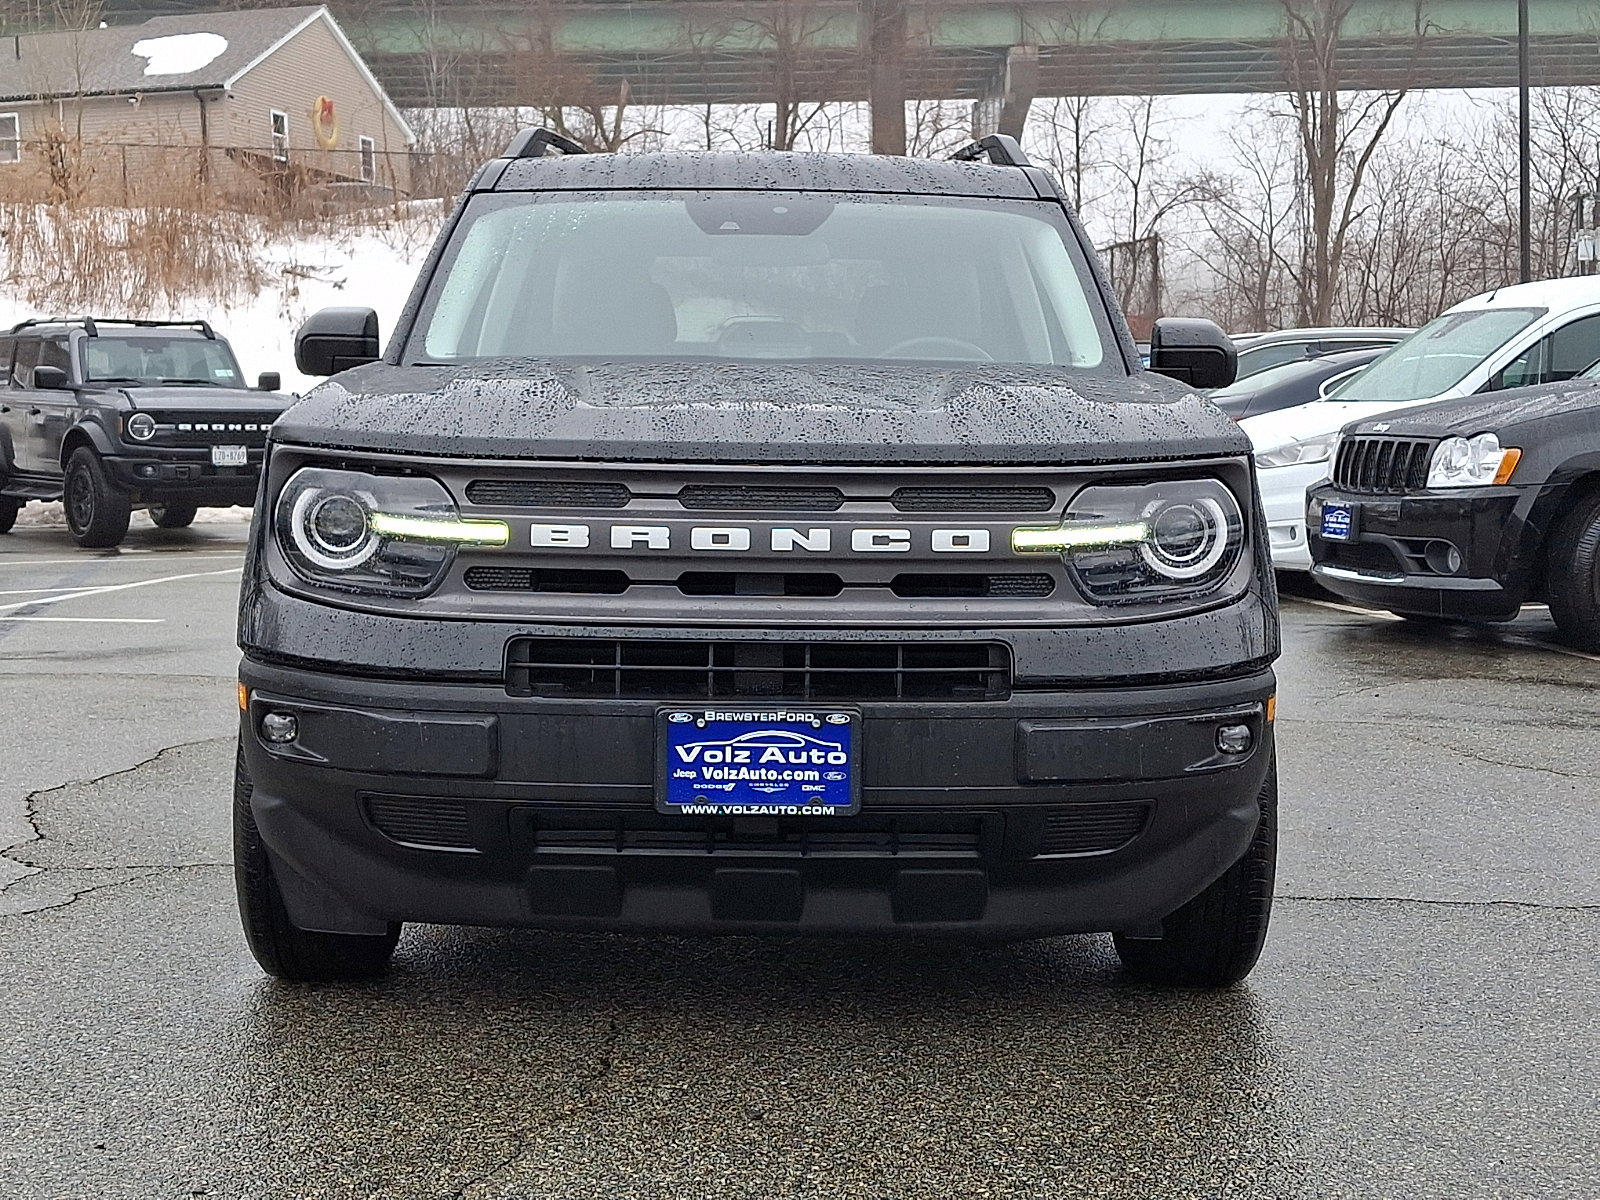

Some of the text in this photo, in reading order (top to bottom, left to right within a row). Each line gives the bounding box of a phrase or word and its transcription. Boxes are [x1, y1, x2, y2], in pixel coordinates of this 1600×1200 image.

[178, 423, 272, 431] BRONCO
[530, 523, 990, 552] BRONCO
[670, 713, 692, 722] Ford
[827, 714, 849, 723] Ford
[675, 746, 847, 764] Volz Auto
[673, 768, 697, 779] Jeep
[701, 767, 820, 781] VolzAuto.com
[823, 771, 846, 780] Ford
[681, 805, 835, 816] WWW.VOLZAUTO.COM
